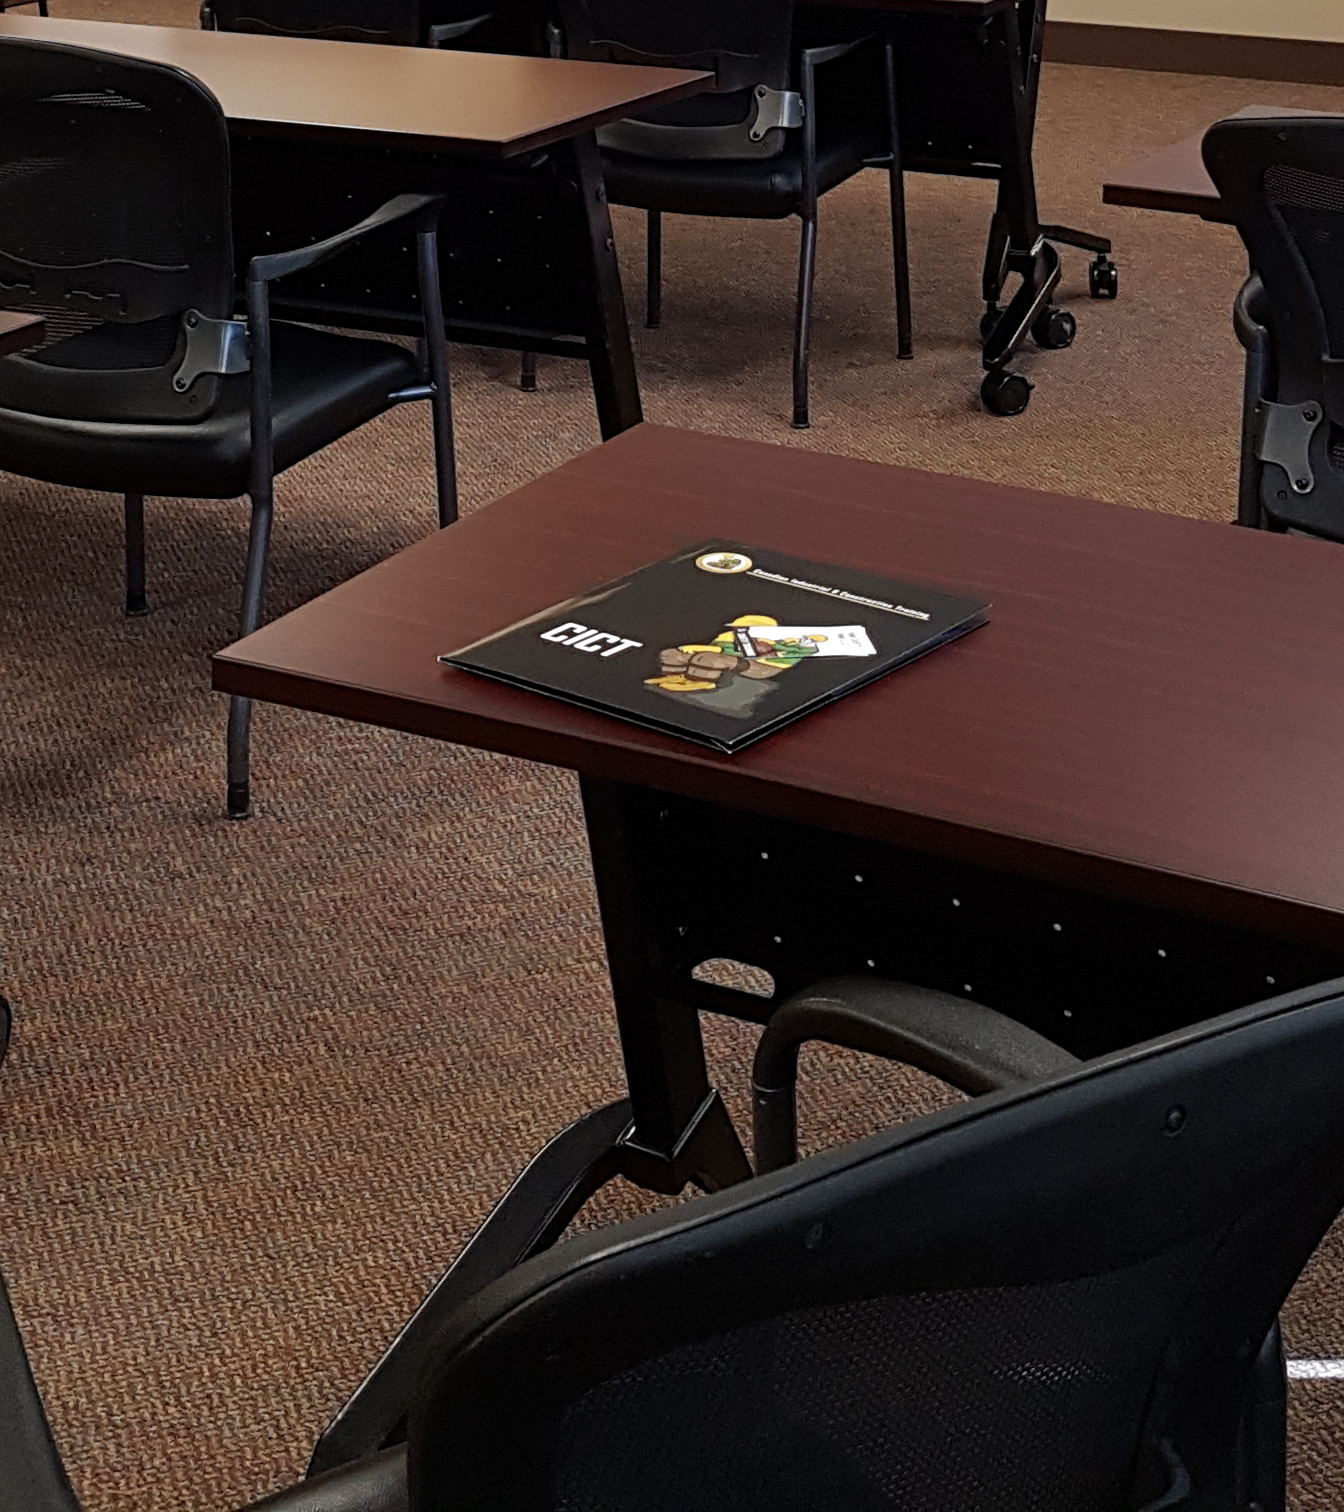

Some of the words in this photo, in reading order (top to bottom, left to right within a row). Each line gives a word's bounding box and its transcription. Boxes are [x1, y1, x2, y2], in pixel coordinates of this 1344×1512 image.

[752, 568, 789, 581] Canadian
[790, 578, 832, 591] Industrial
[839, 591, 894, 609] Construction
[895, 605, 931, 619] Training
[540, 622, 644, 657] CICT
